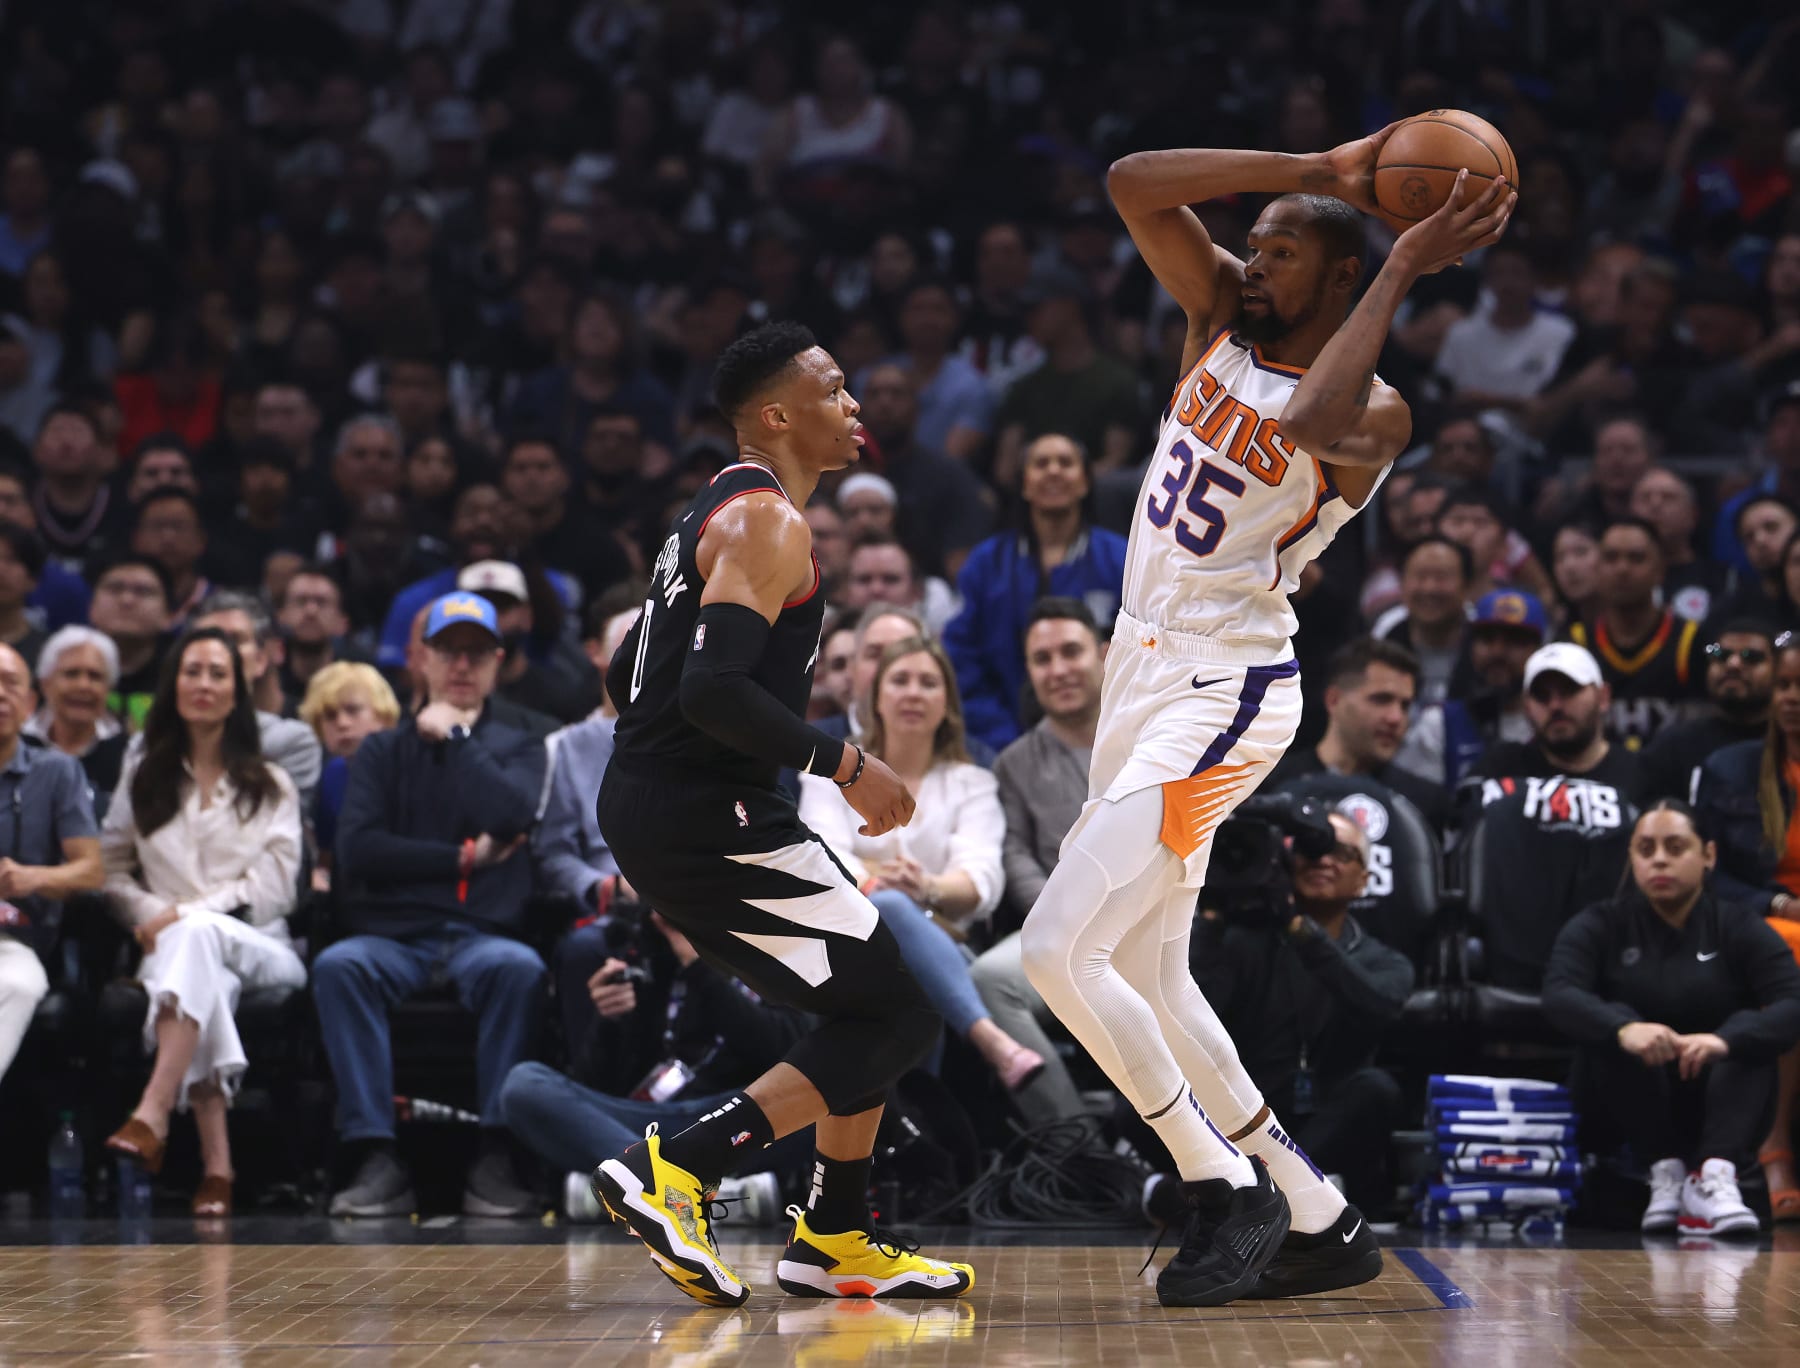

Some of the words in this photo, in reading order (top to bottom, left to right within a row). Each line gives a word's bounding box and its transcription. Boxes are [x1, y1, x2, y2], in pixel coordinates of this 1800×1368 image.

[1176, 368, 1297, 487] SUNS
[1147, 438, 1246, 558] 35
[630, 598, 655, 703] 0
